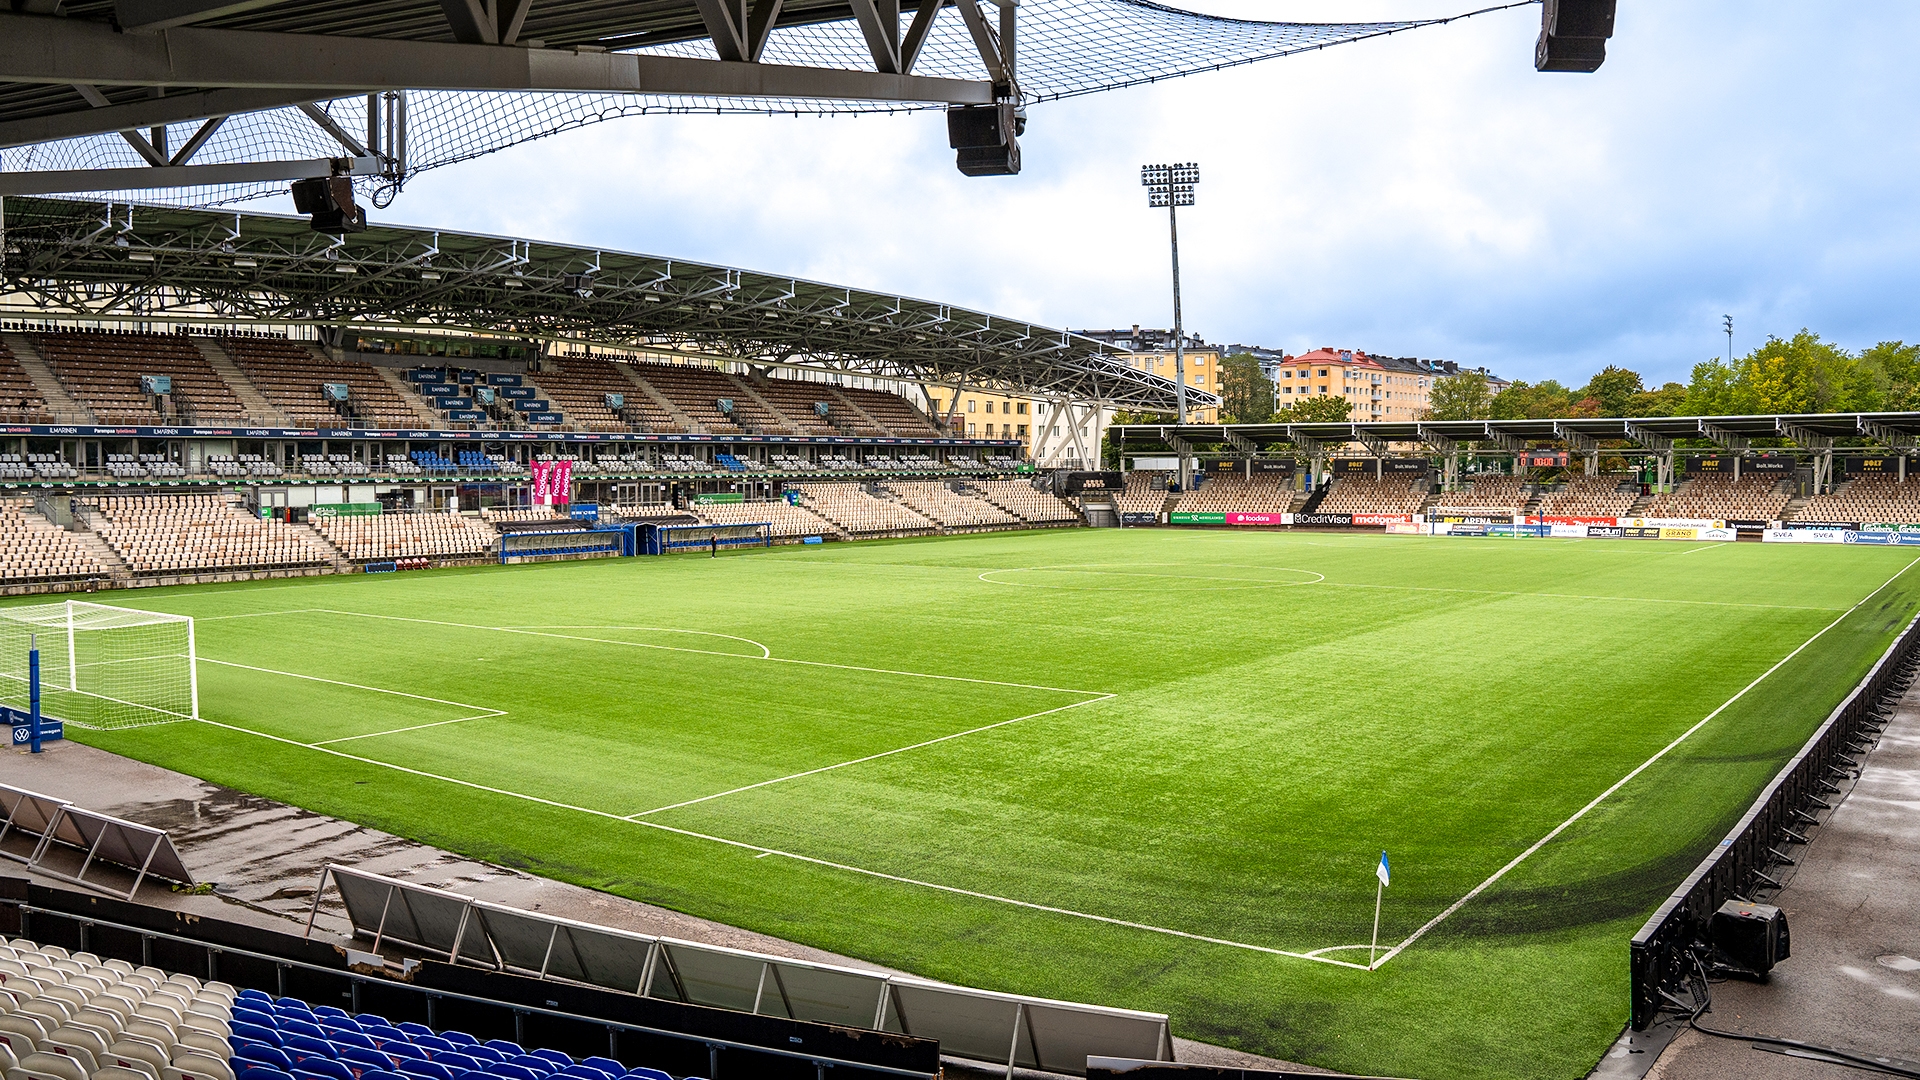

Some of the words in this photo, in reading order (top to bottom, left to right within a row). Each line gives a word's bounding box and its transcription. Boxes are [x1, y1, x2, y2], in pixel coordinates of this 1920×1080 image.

[1521, 458, 1526, 466] 0
[1534, 458, 1553, 466] 00:00
[1561, 458, 1567, 466] 0
[537, 468, 548, 497] foodora
[553, 468, 562, 496] foodora
[562, 468, 570, 496] foodora
[1302, 514, 1351, 525] CreditVisor
[1355, 515, 1406, 523] motonet
